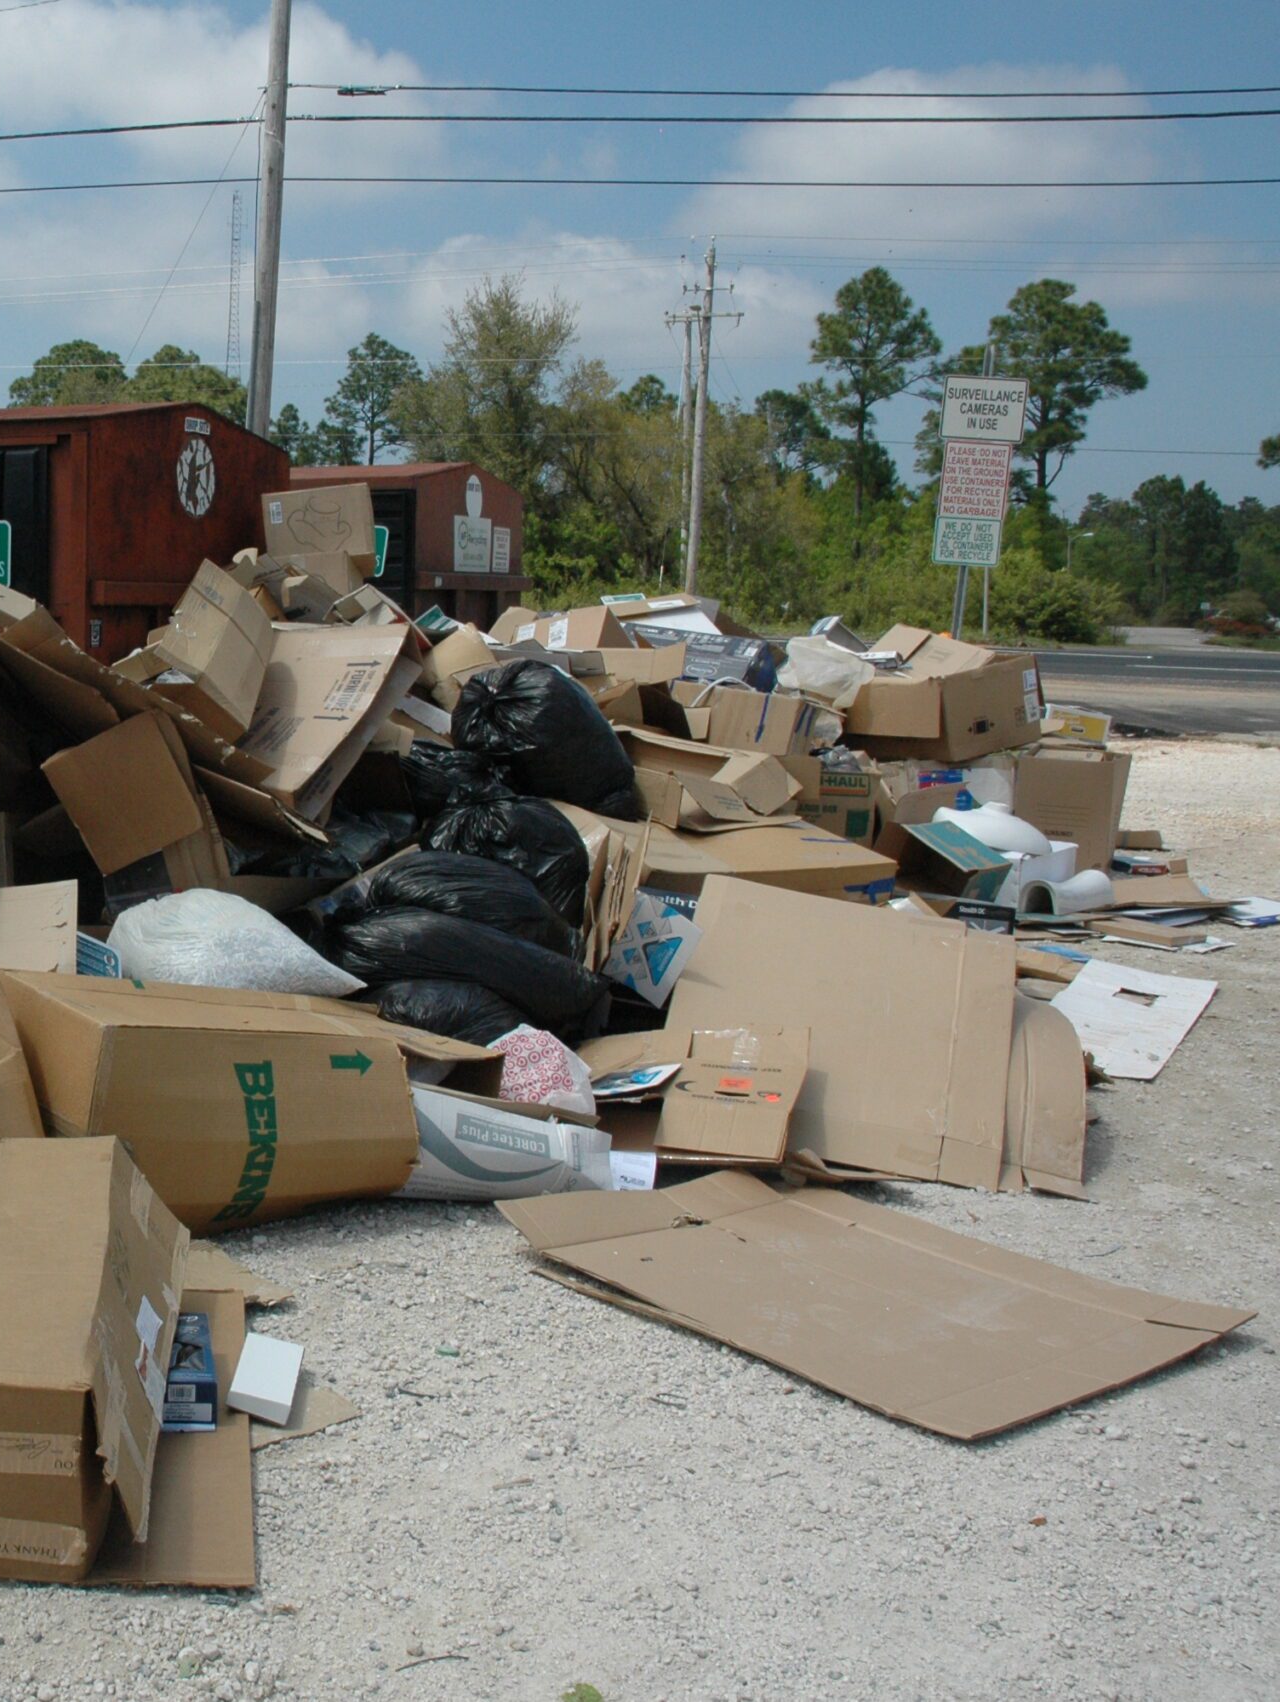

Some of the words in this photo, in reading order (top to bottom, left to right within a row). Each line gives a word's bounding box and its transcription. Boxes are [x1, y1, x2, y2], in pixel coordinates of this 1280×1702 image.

[947, 387, 1024, 403] SURVEILLANCE
[960, 402, 1009, 417] CAMERAS
[967, 418, 976, 429] IN
[979, 418, 998, 430] USE
[949, 446, 977, 456] PLEASE
[980, 448, 990, 457] DO
[992, 449, 1007, 458] NOT
[948, 456, 969, 466] LEAVE
[970, 458, 1006, 468] MATERIAL
[945, 466, 956, 474] ON
[958, 466, 971, 476] THE
[973, 467, 1004, 478] GROUND
[944, 476, 958, 485] USE
[960, 477, 1005, 487] CONTAINERS
[946, 485, 962, 494] FOR
[964, 487, 1001, 497] RECYCLE
[943, 495, 980, 506] MATERIALS
[943, 505, 955, 514] NO
[945, 521, 957, 530] WE
[961, 522, 972, 532] DO
[976, 523, 992, 533] NOT
[942, 531, 970, 541] ACCEPT
[974, 532, 993, 542] USED
[952, 540, 994, 551] CONTAINERS
[939, 549, 955, 559] FOR
[957, 550, 992, 560] RECYCLE
[330, 669, 366, 712] FURNITURE
[462, 1124, 489, 1142] Plus
[212, 1060, 278, 1222] BEKINS
[493, 1132, 546, 1154] COREtec
[53, 1460, 74, 1470] OU
[12, 1545, 60, 1559] THANK
